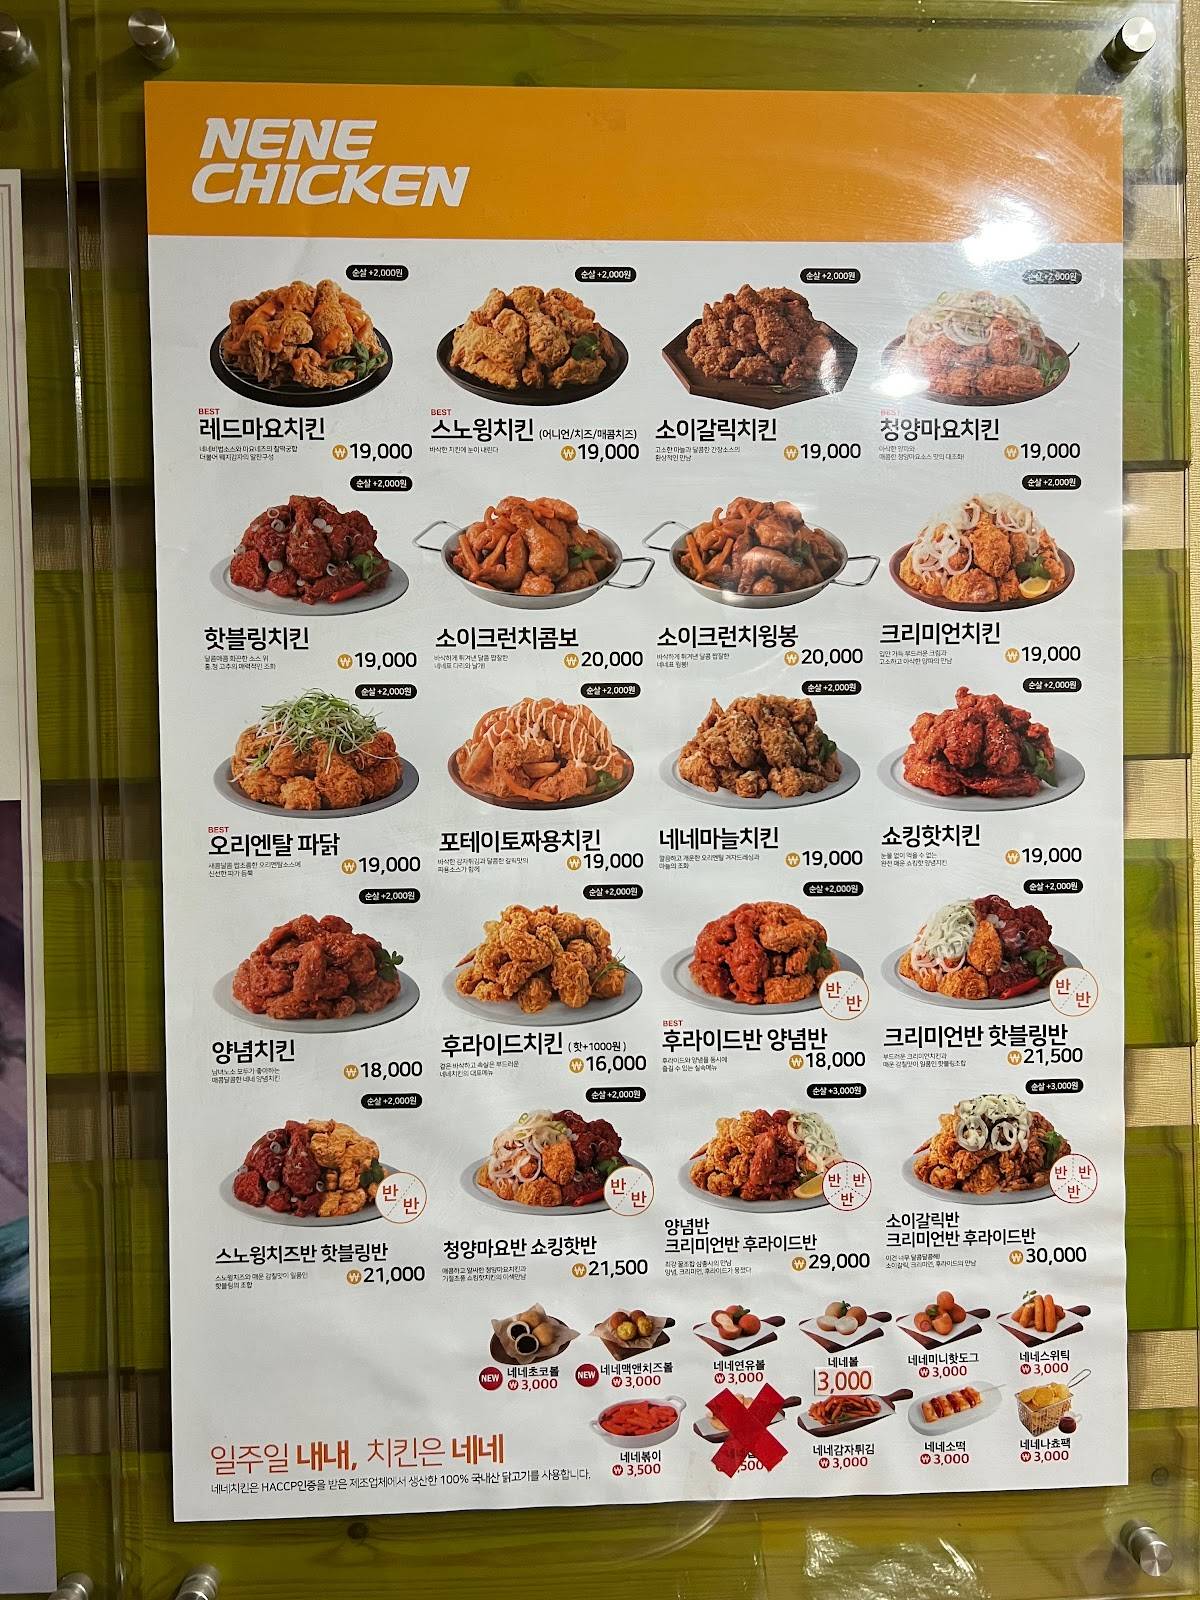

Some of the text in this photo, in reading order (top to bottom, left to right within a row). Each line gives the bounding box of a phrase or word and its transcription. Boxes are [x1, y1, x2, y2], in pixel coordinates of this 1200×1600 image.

[200, 118, 378, 160] NENE
[191, 163, 470, 207] CHICKEN
[352, 268, 403, 278] 순살 +2,000원
[580, 270, 632, 280] 순살 +2,000원
[806, 271, 856, 280] 순살 +2,000원
[198, 408, 220, 416] BEST
[430, 408, 452, 416] BEST
[200, 418, 325, 440] 레드마요치킨
[431, 418, 638, 442] 스노윙치킨 (어니언/치즈/매콤치즈)
[656, 418, 776, 442] 소이갈릭치킨
[880, 418, 999, 442] 청양마요치킨
[356, 478, 407, 488] 순살 +2,000원
[1027, 478, 1076, 487] 순살 +2,000원
[204, 627, 309, 651] 핫블링치킨
[436, 626, 579, 650] 소이크런치콤보
[657, 624, 798, 648] 소이크런치윙봉
[880, 622, 1000, 646] 크리미언치킨
[361, 687, 412, 696] 순살 +2,000원
[586, 686, 636, 696] 순살 +2,000원
[807, 683, 856, 693] 순살 +2,000원
[1028, 680, 1076, 690] 순살 +2,000원
[439, 830, 600, 853] 포테이토짜용치킨
[660, 826, 778, 850] 네네마늘치킨
[881, 824, 980, 848] 쇼킹핫치킨
[208, 832, 340, 857] 오리엔탈 파닭
[588, 887, 638, 897] 순살 +2,000원
[808, 885, 858, 894] 순살 +2,000원
[1029, 882, 1078, 891] 순살 +2,000원
[365, 891, 415, 900] 순살 +2,000원
[826, 982, 862, 1012] 반 반
[1056, 978, 1091, 1008] 반 반
[662, 1028, 827, 1052] 후라이드반 양념반
[884, 1024, 1068, 1048] 크리미언반 핫블링반
[212, 1039, 295, 1064] 양념치킨
[441, 1032, 562, 1057] 후라이드치킨
[812, 1086, 862, 1095] 순살 +3,000원
[1031, 1082, 1079, 1091] 순살 +3,000원
[367, 1096, 417, 1106] 순살 +2,000원
[591, 1090, 640, 1100] 순살 +2,000원
[1054, 1165, 1092, 1180] 반 반
[828, 1173, 866, 1188] 반 반
[382, 1184, 419, 1215] 반 반
[611, 1178, 647, 1208] 반 반
[841, 1192, 854, 1207] 반
[1068, 1185, 1080, 1199] 반
[664, 1217, 710, 1236] 양념반
[886, 1211, 959, 1229] 소이갈릭반
[664, 1234, 817, 1254] 크리미언반 후라이드반
[886, 1228, 1036, 1248] 크리미언반 후라이드반
[215, 1243, 388, 1265] 스노윙치즈반 핫블링반
[444, 1236, 597, 1260] 청양마요반 쇼킹핫반
[828, 1356, 858, 1368] 네네볼
[908, 1353, 979, 1366] 네네미니핫도그
[1019, 1350, 1070, 1362] 네네스위틱
[507, 1365, 559, 1378] 네네초코볼
[600, 1362, 673, 1376] 네네맥앤치즈볼
[713, 1360, 765, 1372] 네네연유볼
[481, 1374, 500, 1383] NEW
[578, 1371, 596, 1379] NEW
[817, 1371, 872, 1394] 3,000
[813, 1444, 875, 1456] 네네감자튀김
[925, 1441, 966, 1453] 네네소떡
[1020, 1438, 1071, 1450] 네네나쵸팩
[210, 1433, 504, 1475] 일주일 내내, 치킨은 네네
[620, 1450, 661, 1463] 네네볶이
[211, 1469, 591, 1495] 네네치킨은 HACCP인증을 받은 제조업체에서 생산한 100% 국내산 닭고기를 사용합니다.
